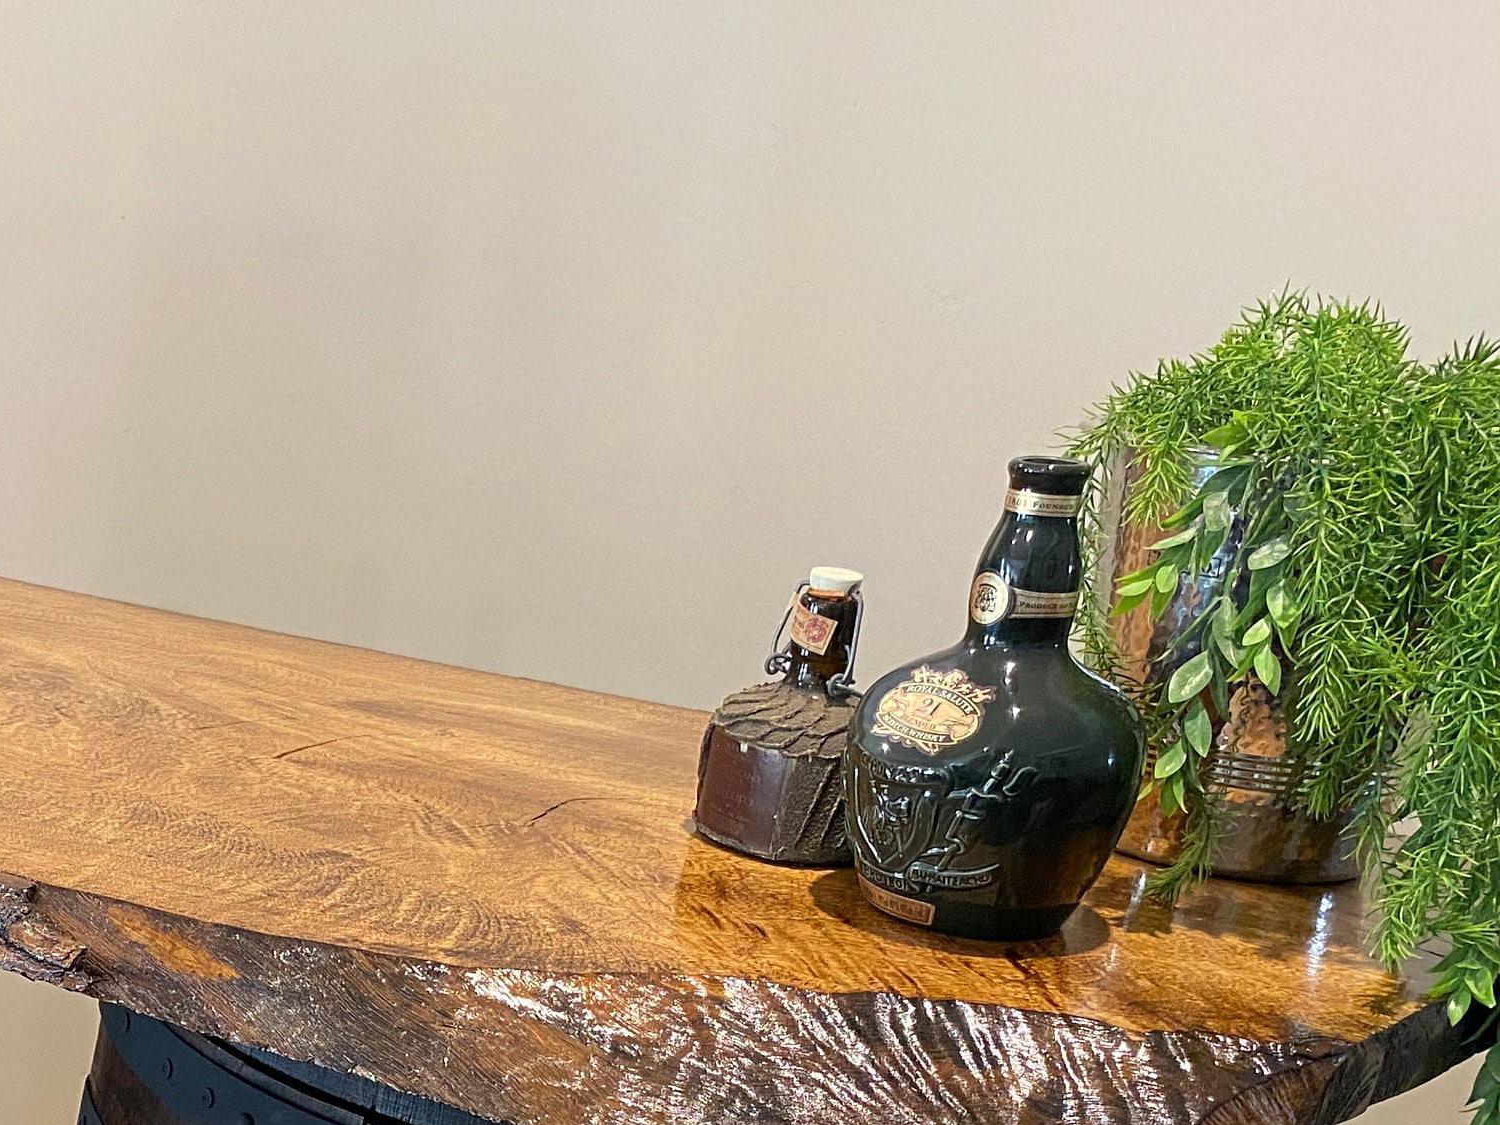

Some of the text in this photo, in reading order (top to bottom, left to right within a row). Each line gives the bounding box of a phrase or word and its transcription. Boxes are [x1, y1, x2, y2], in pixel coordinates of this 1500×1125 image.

[907, 685, 973, 714] ROYAL SALUTE
[916, 697, 941, 716] 21
[882, 714, 946, 742] SCOTCH WHISKY
